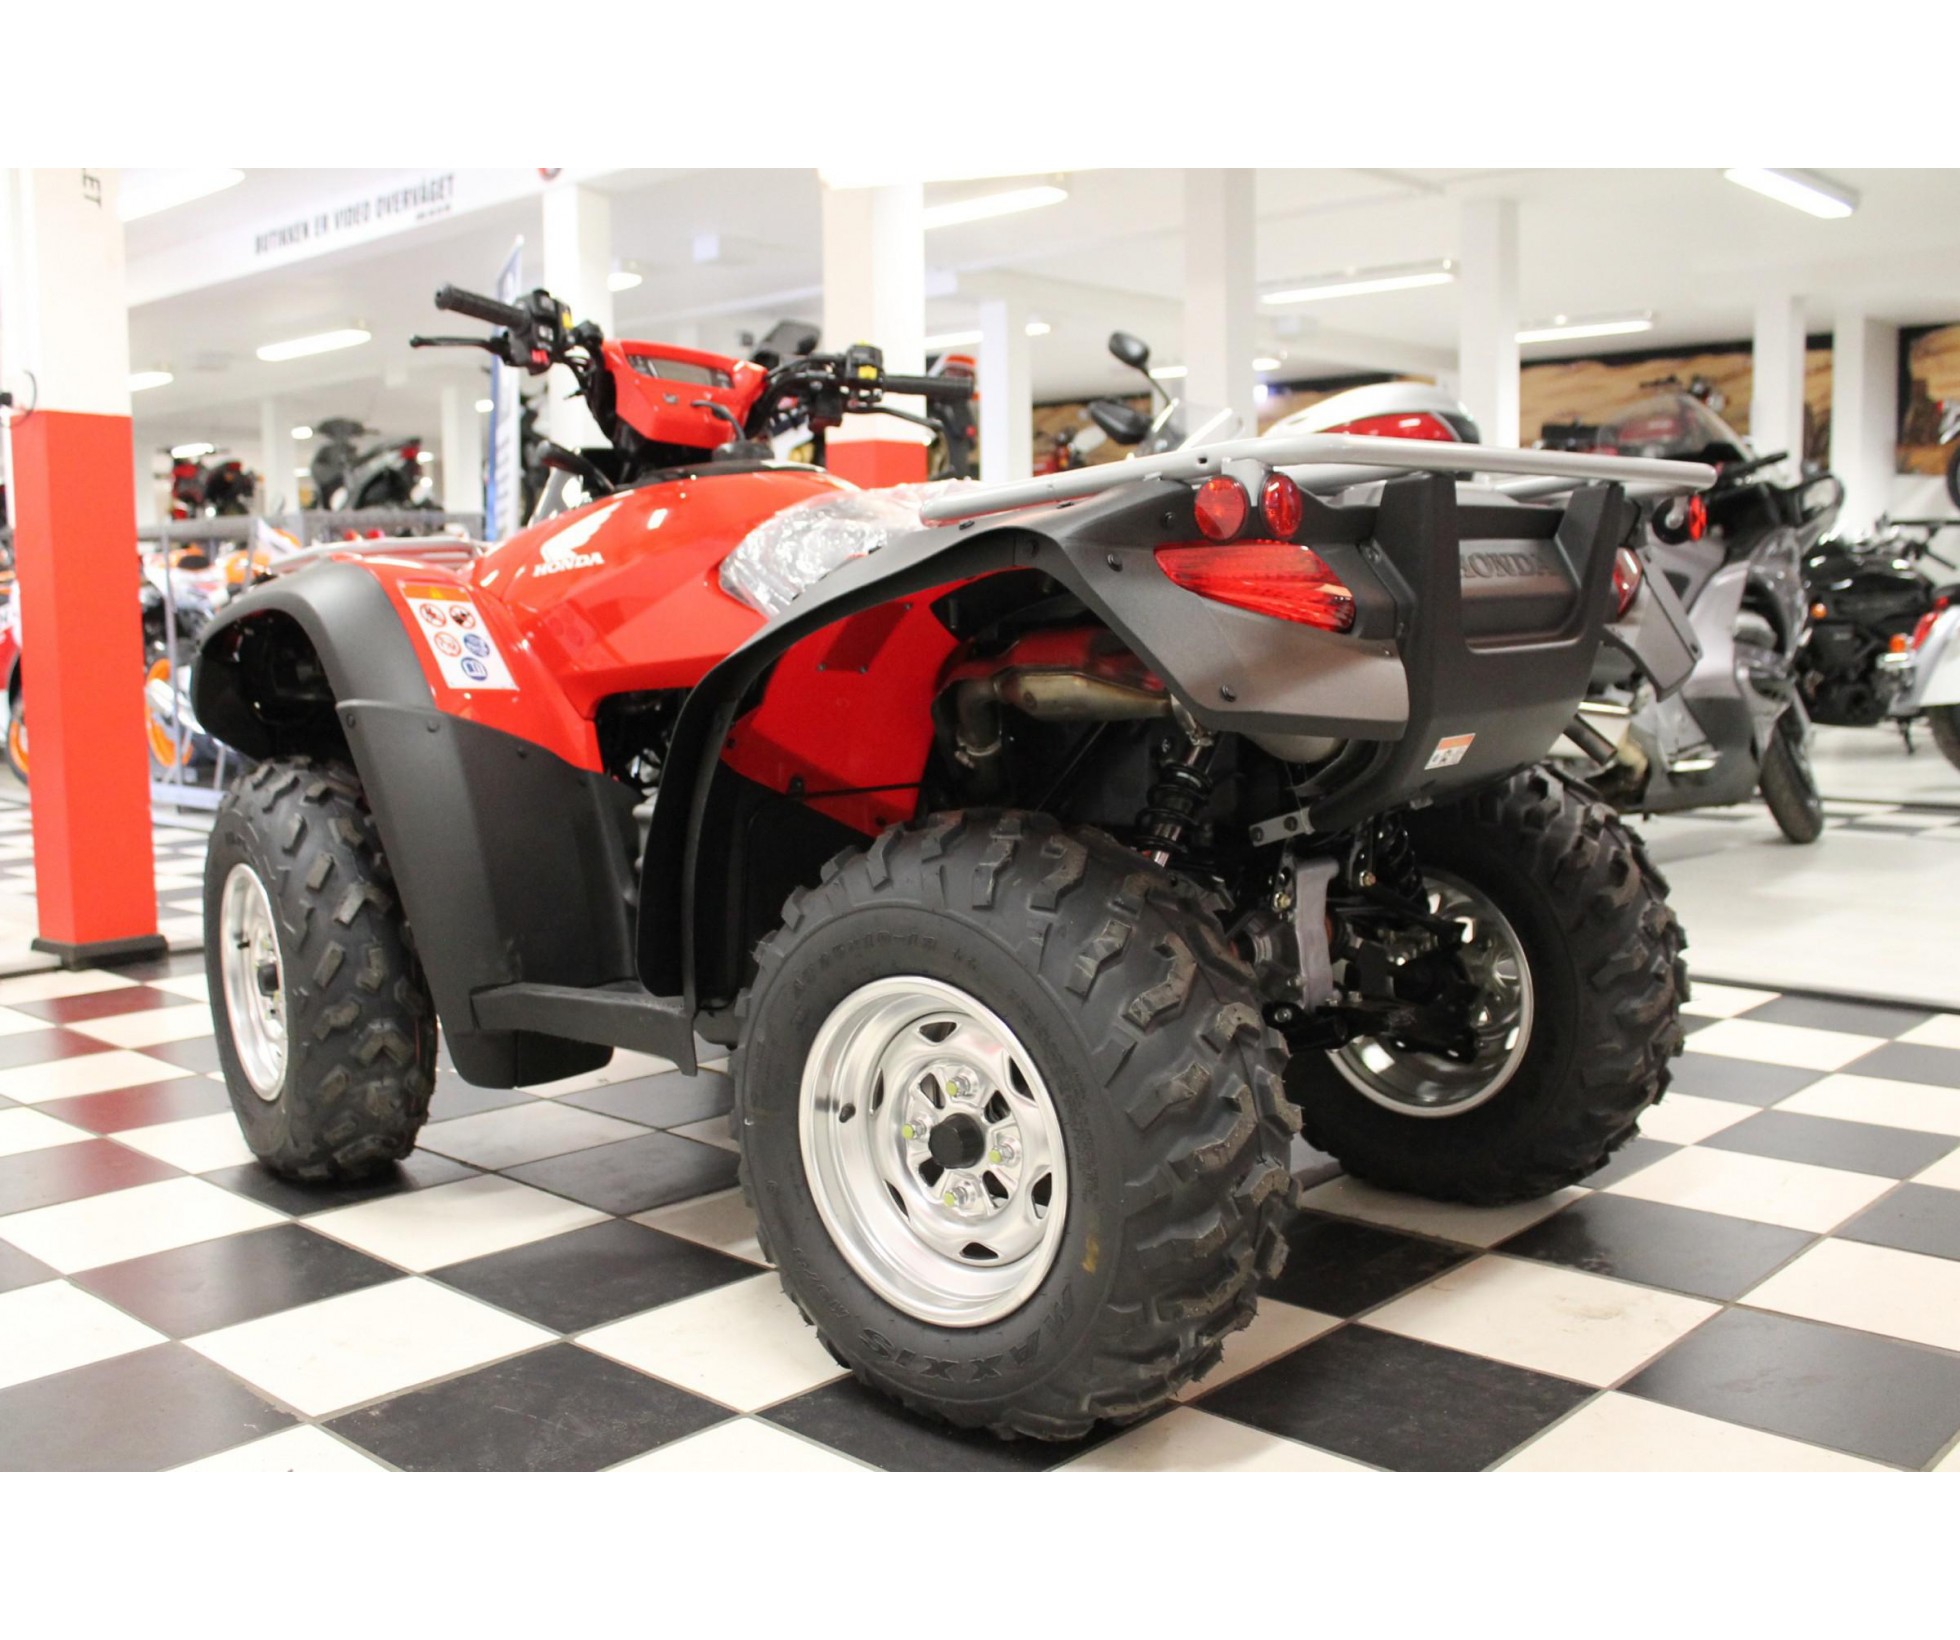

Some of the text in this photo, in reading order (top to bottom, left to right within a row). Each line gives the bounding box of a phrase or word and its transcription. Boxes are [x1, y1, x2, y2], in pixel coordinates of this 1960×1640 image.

[82, 168, 102, 208] ET
[334, 200, 370, 230] VIDEO
[533, 551, 605, 577] HONDA
[1460, 552, 1556, 578] ONDA
[859, 1283, 1075, 1383] MAXXIS
